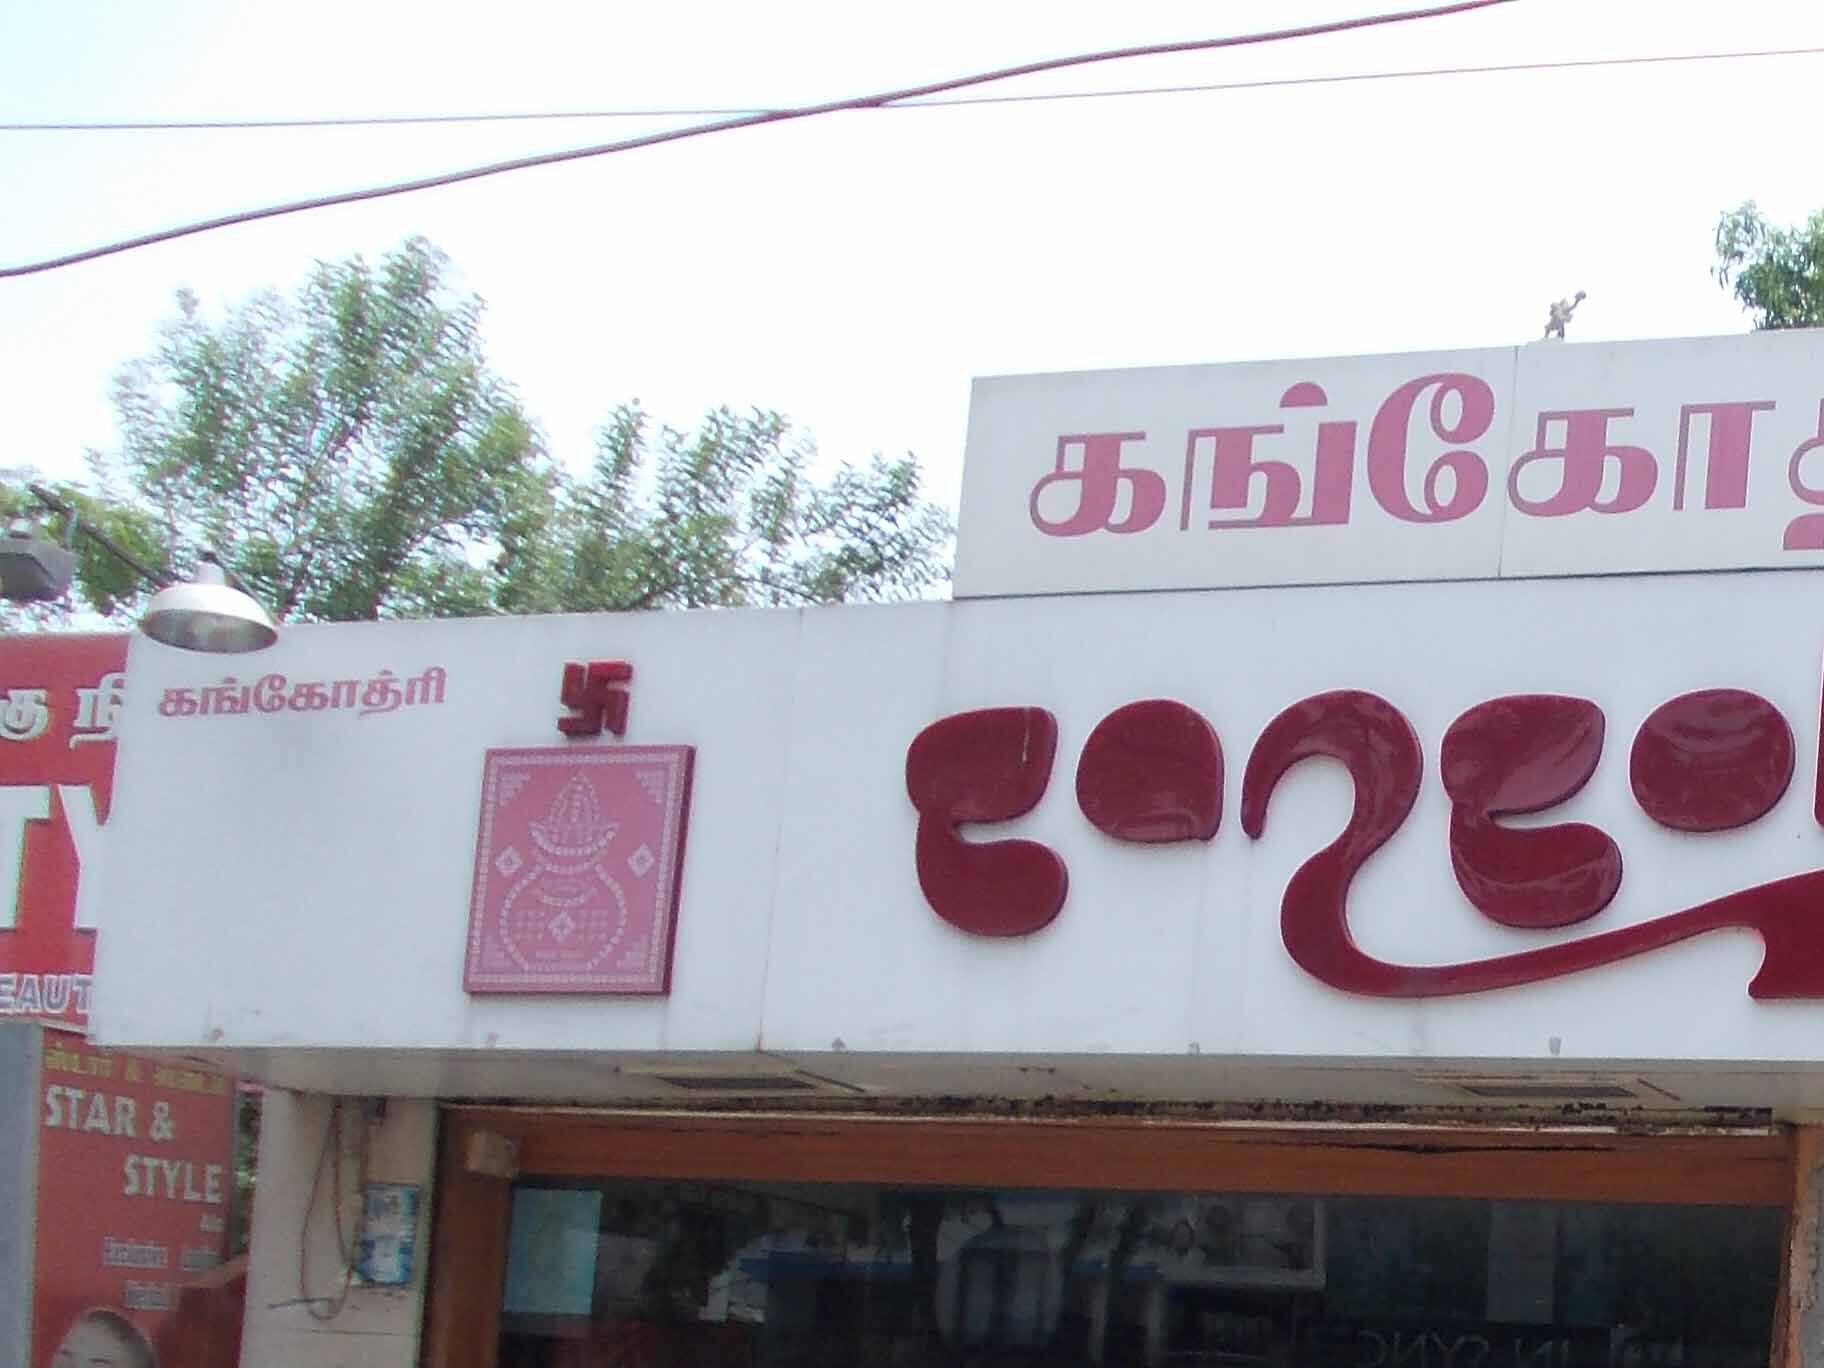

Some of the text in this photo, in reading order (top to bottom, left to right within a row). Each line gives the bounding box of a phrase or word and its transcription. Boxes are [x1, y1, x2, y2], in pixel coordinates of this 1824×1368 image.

[45, 1084, 174, 1141] STAR &
[123, 1154, 224, 1203] STYLE
